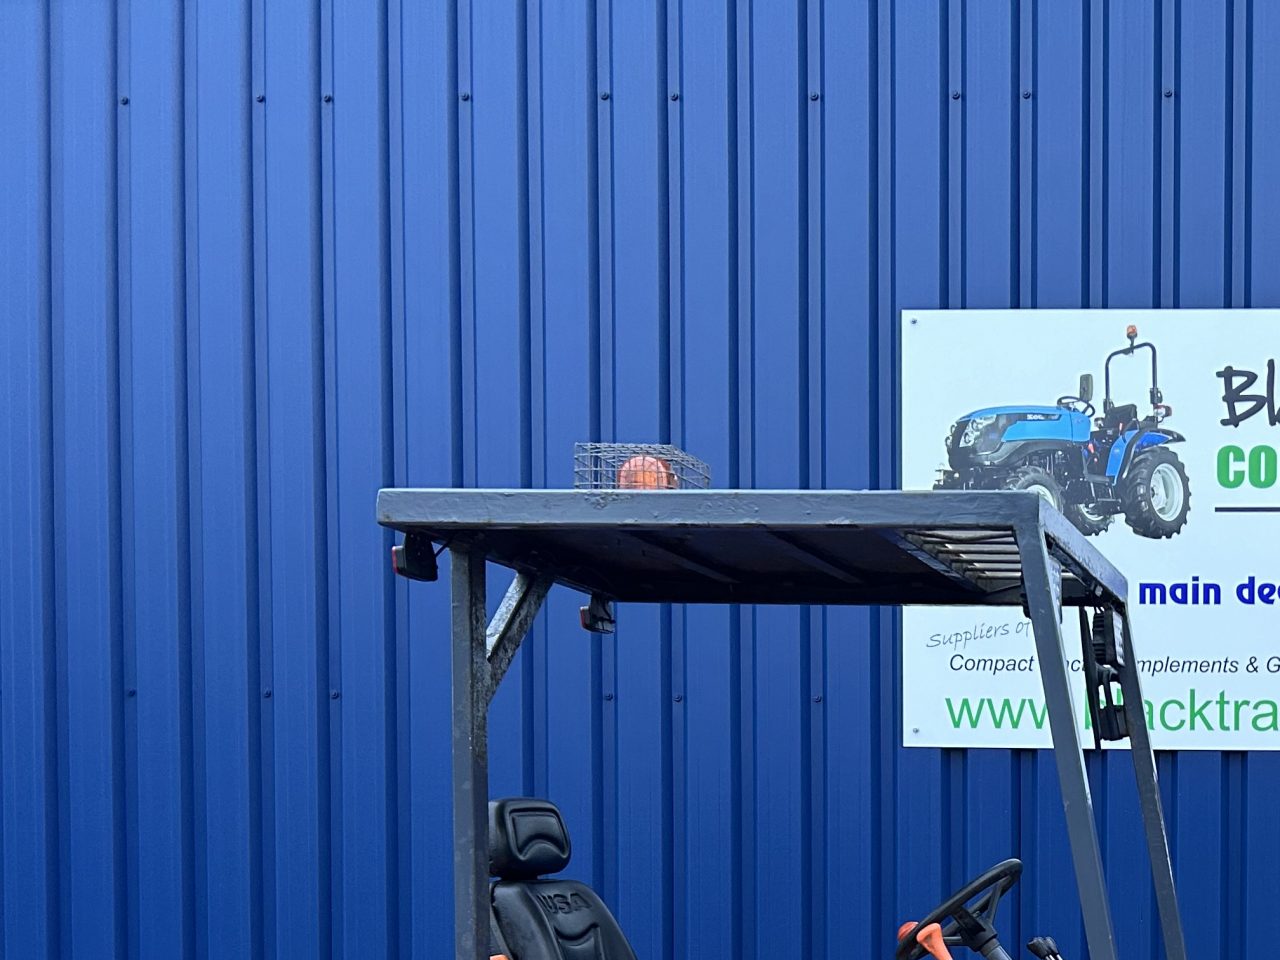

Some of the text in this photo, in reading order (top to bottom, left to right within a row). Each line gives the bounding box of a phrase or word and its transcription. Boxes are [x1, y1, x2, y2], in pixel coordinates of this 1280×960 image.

[1139, 576, 1221, 605] main
[926, 622, 1010, 651] Suppliers
[949, 653, 1035, 675] Compact
[1137, 655, 1239, 676] mplements
[1245, 656, 1259, 673] &
